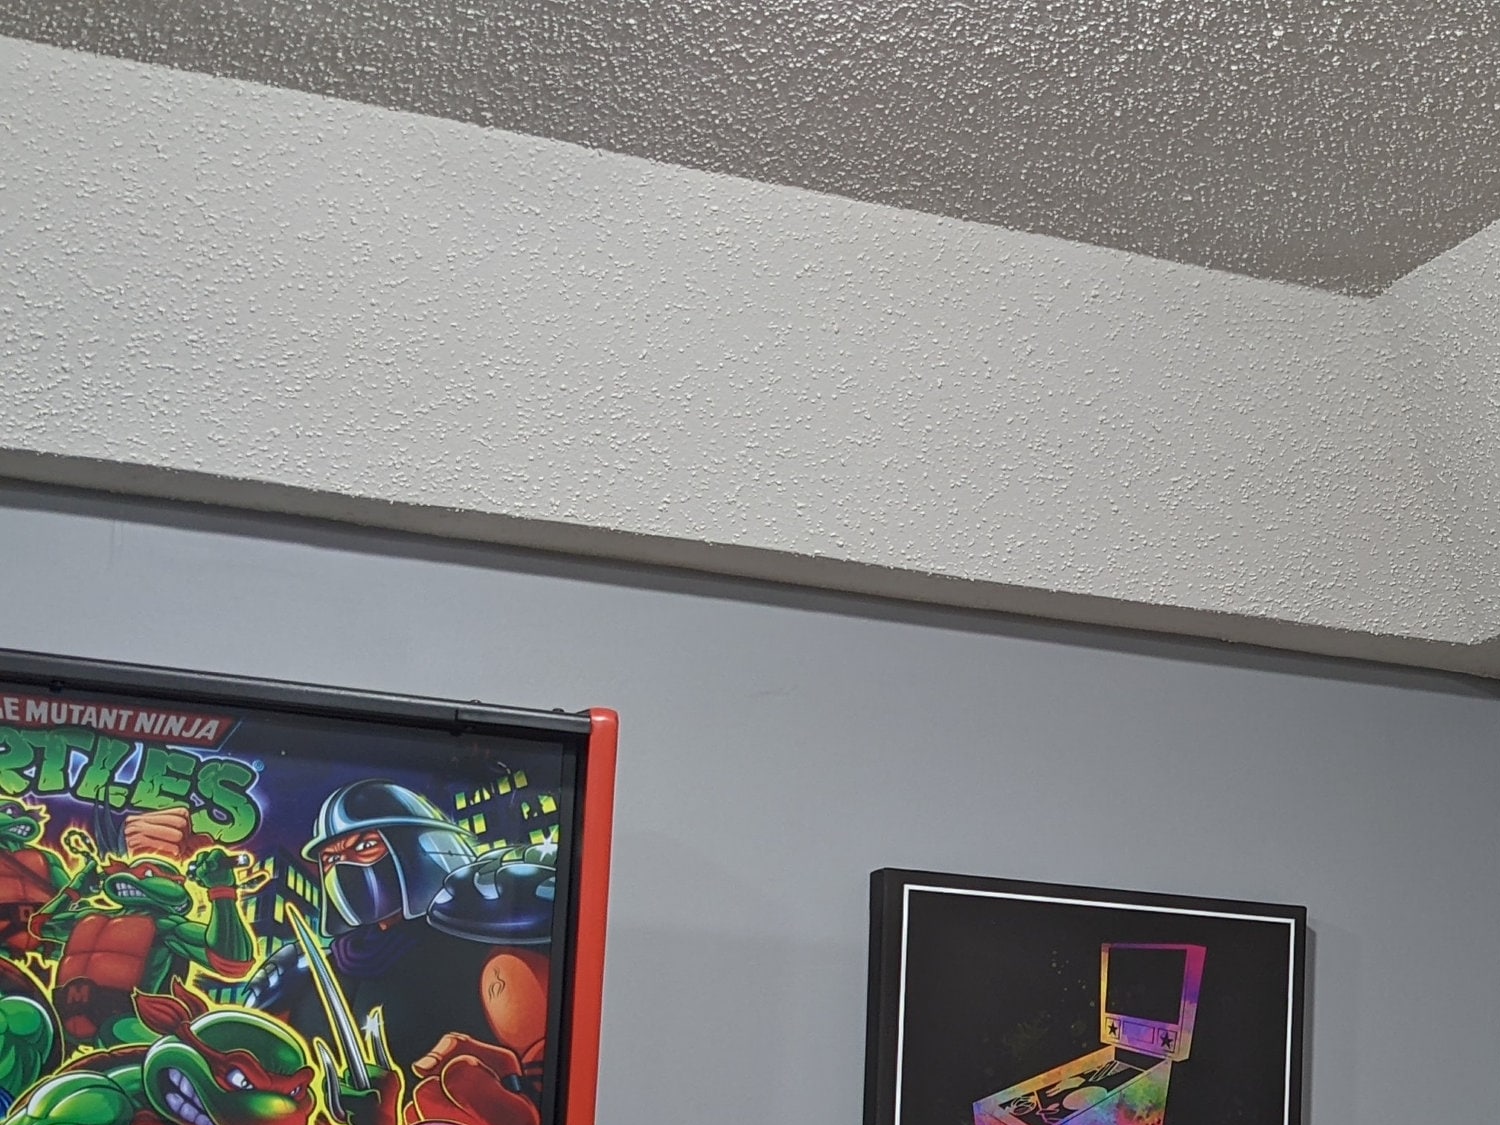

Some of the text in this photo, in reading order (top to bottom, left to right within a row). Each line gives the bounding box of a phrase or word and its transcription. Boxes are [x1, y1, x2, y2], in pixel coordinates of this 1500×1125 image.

[0, 697, 220, 741] E MUTANT NINJA
